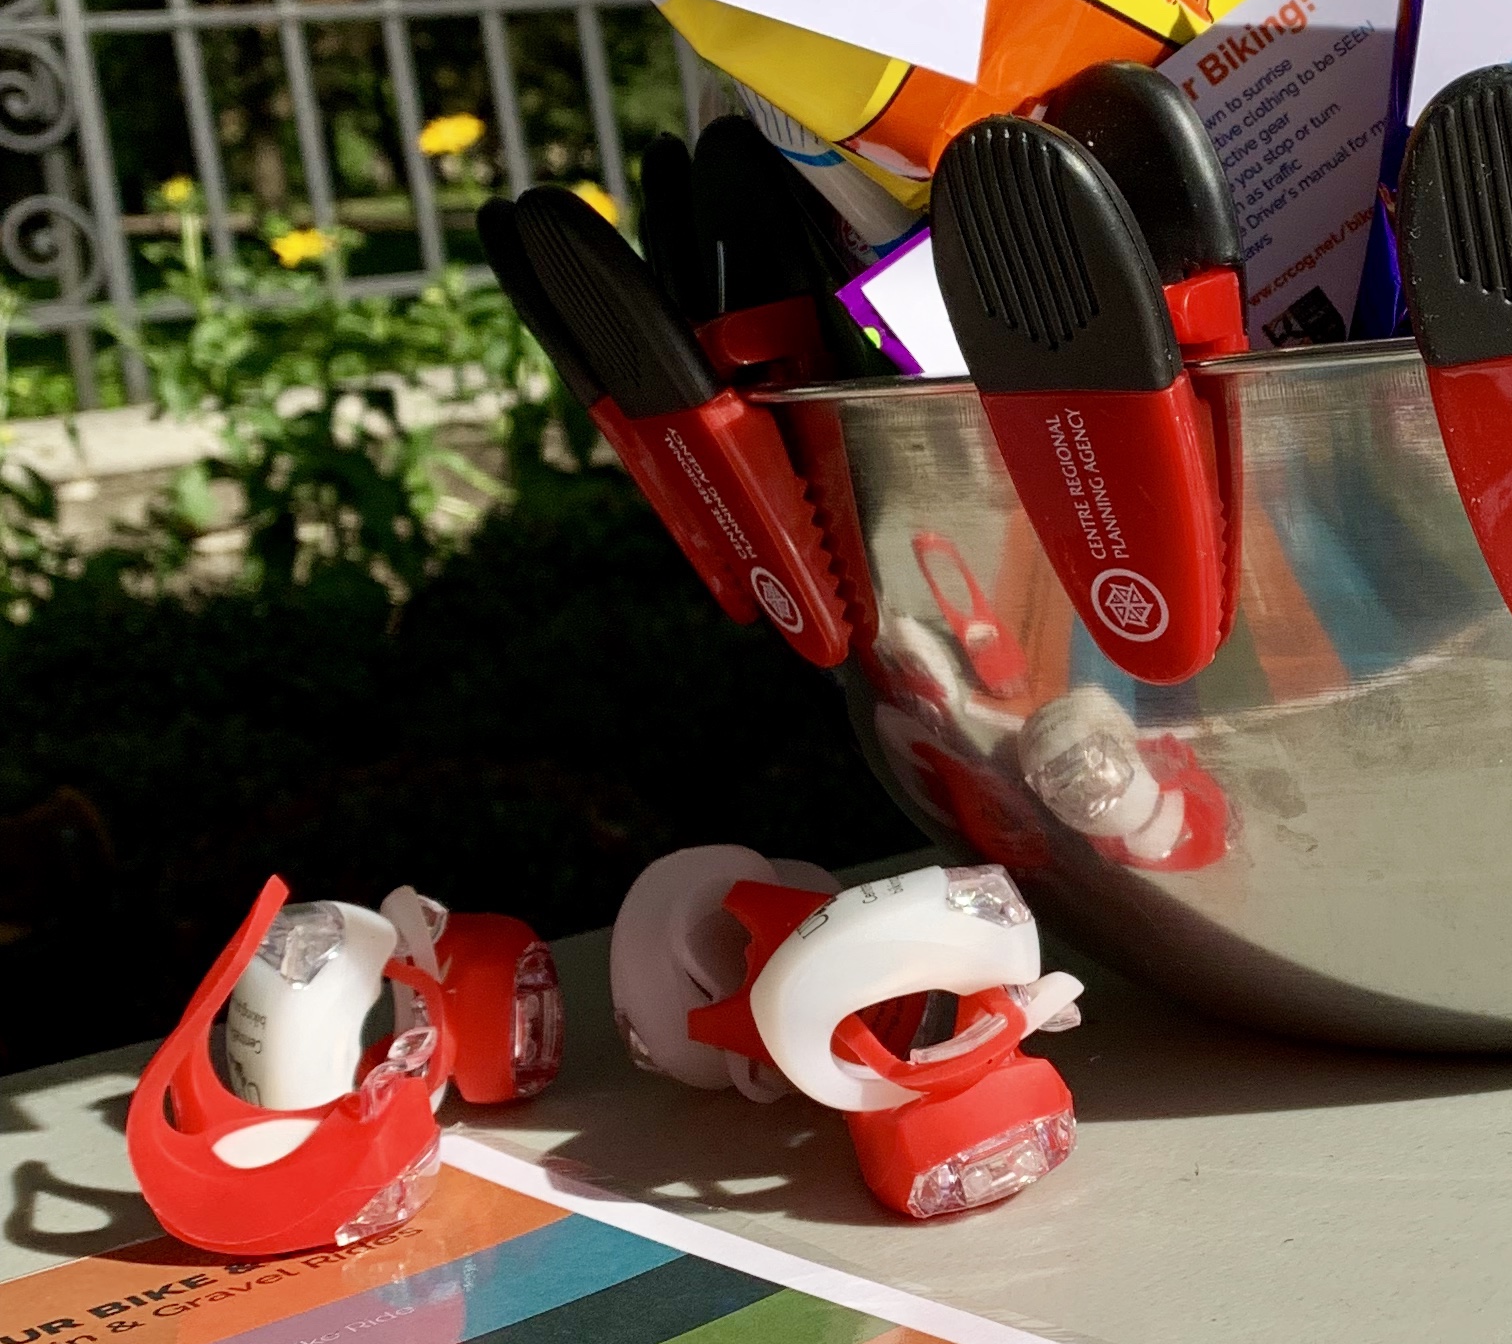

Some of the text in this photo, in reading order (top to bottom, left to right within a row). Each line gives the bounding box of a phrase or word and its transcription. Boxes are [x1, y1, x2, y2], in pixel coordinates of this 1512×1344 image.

[1046, 414, 1106, 559] CENTRE REGIONAL
[1065, 409, 1129, 558] PLANNING AGENCY
[151, 1224, 424, 1318] Gravel Rides
